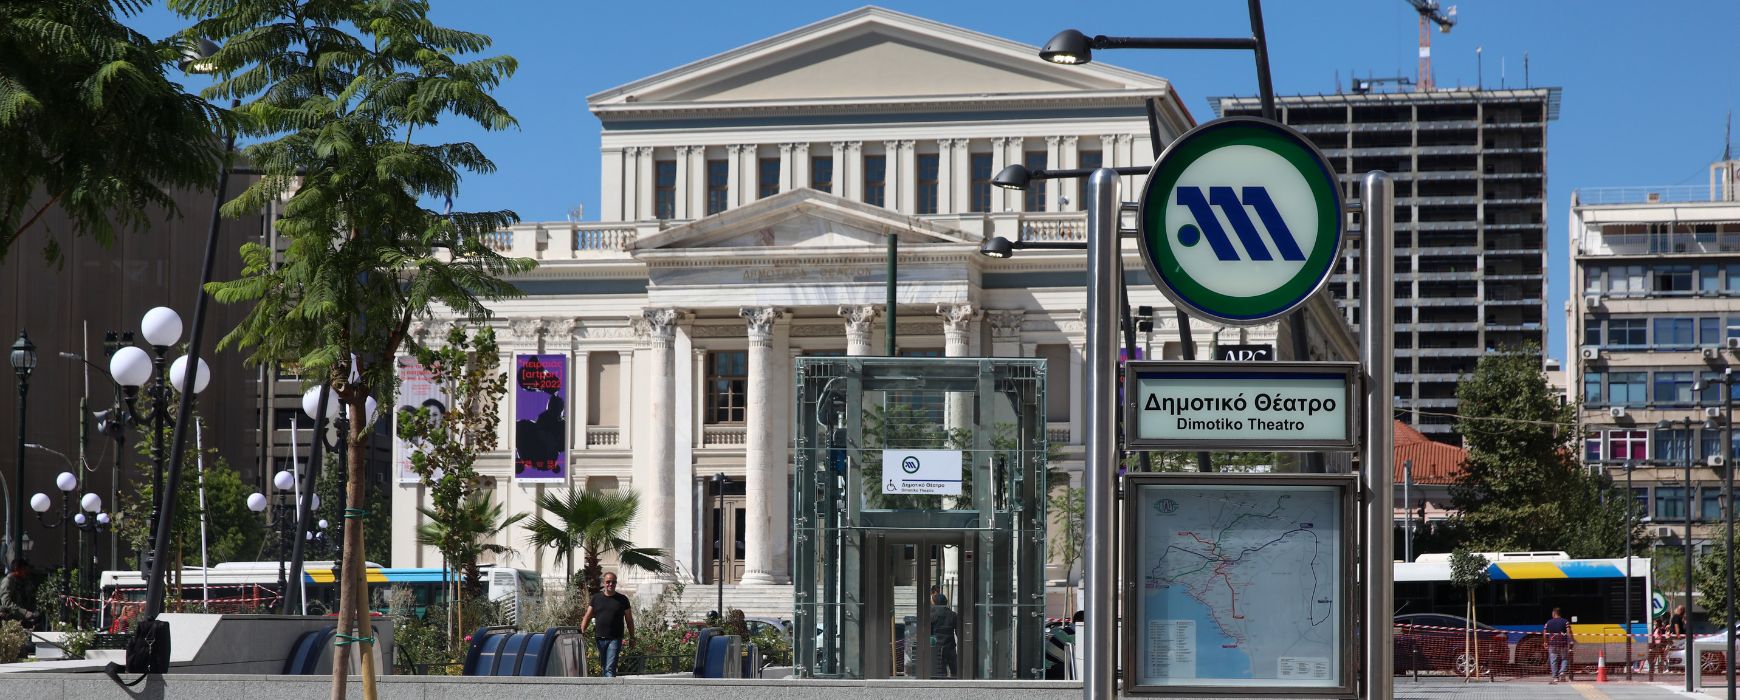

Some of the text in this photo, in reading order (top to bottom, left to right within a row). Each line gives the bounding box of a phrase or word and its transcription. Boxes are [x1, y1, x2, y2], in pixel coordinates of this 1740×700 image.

[540, 380, 561, 388] 2022
[1144, 392, 1337, 416] Δημοτικό Θέατρο
[1177, 417, 1305, 431] Dimotiko Theatro
